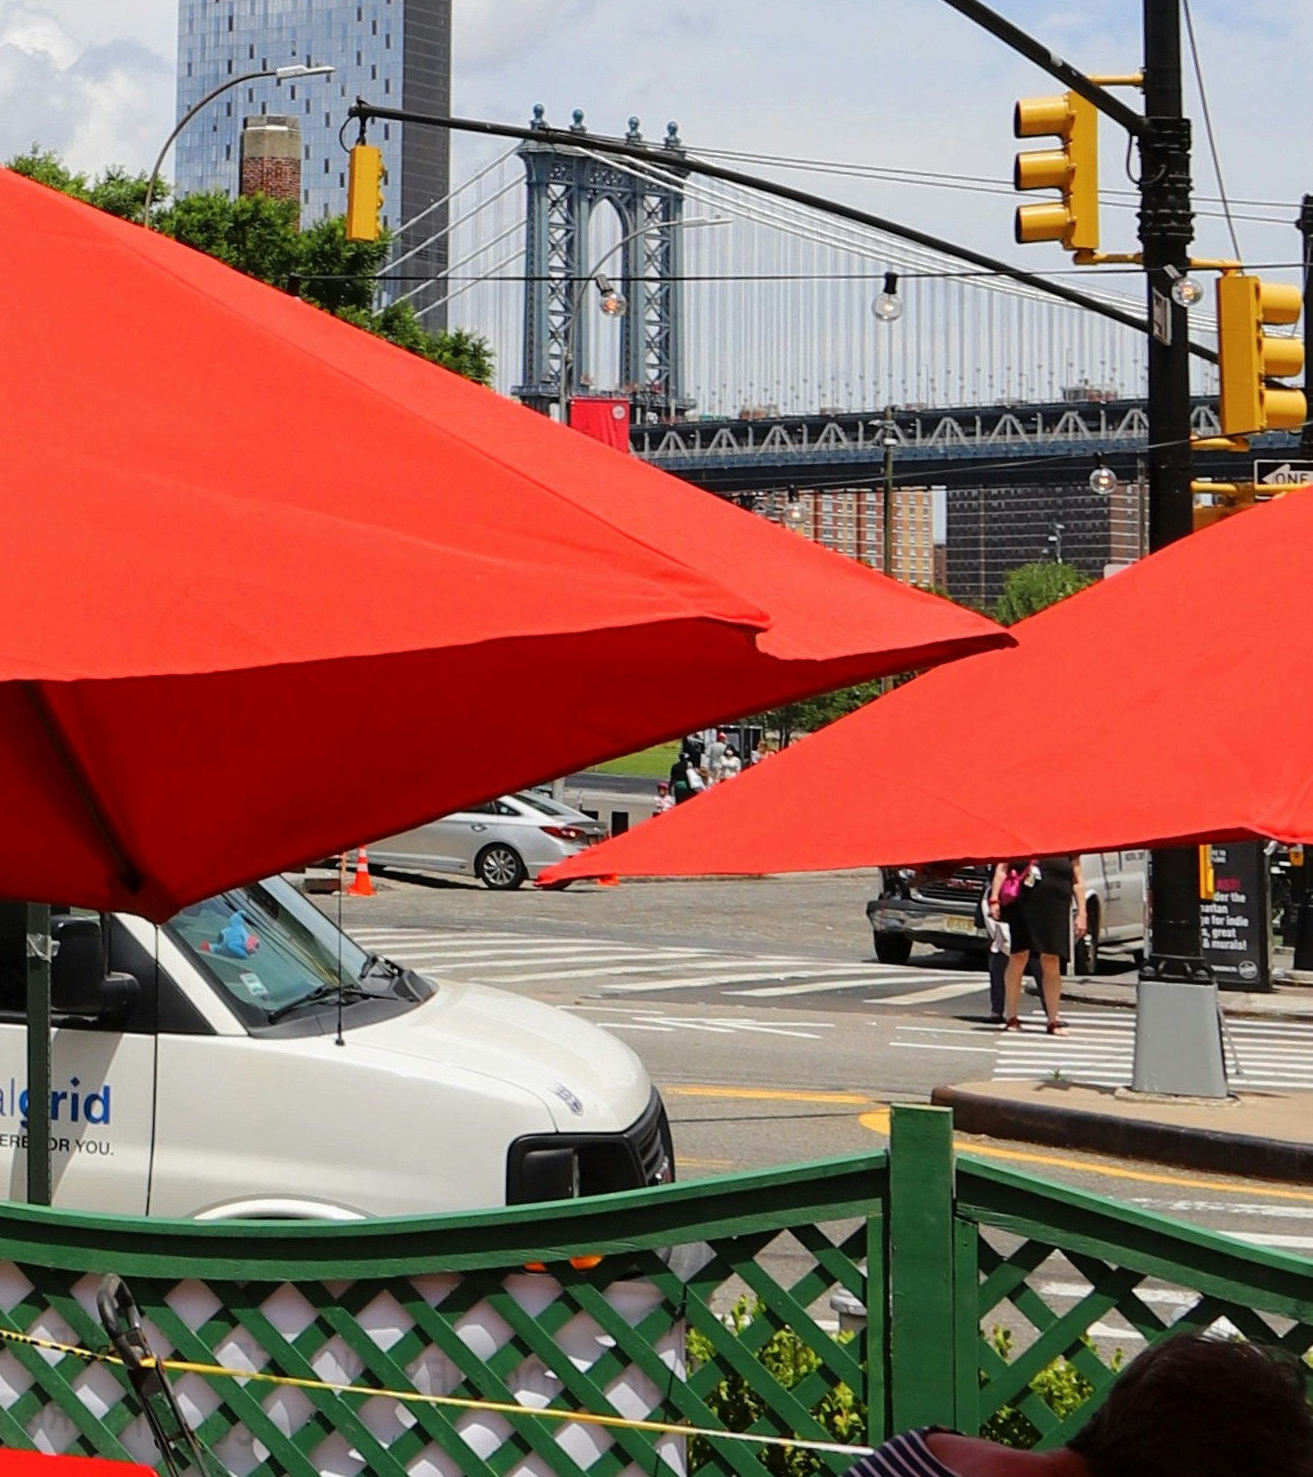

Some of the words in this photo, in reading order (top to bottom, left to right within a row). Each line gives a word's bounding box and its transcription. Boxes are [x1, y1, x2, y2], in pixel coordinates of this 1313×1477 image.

[1275, 472, 1309, 485] ONE
[1214, 892, 1229, 903] der
[1231, 892, 1247, 903] the
[1200, 904, 1229, 914] attan
[1212, 915, 1225, 926] for
[1212, 928, 1237, 939] great
[48, 1137, 70, 1152] OR
[75, 1139, 114, 1156] YOU.
